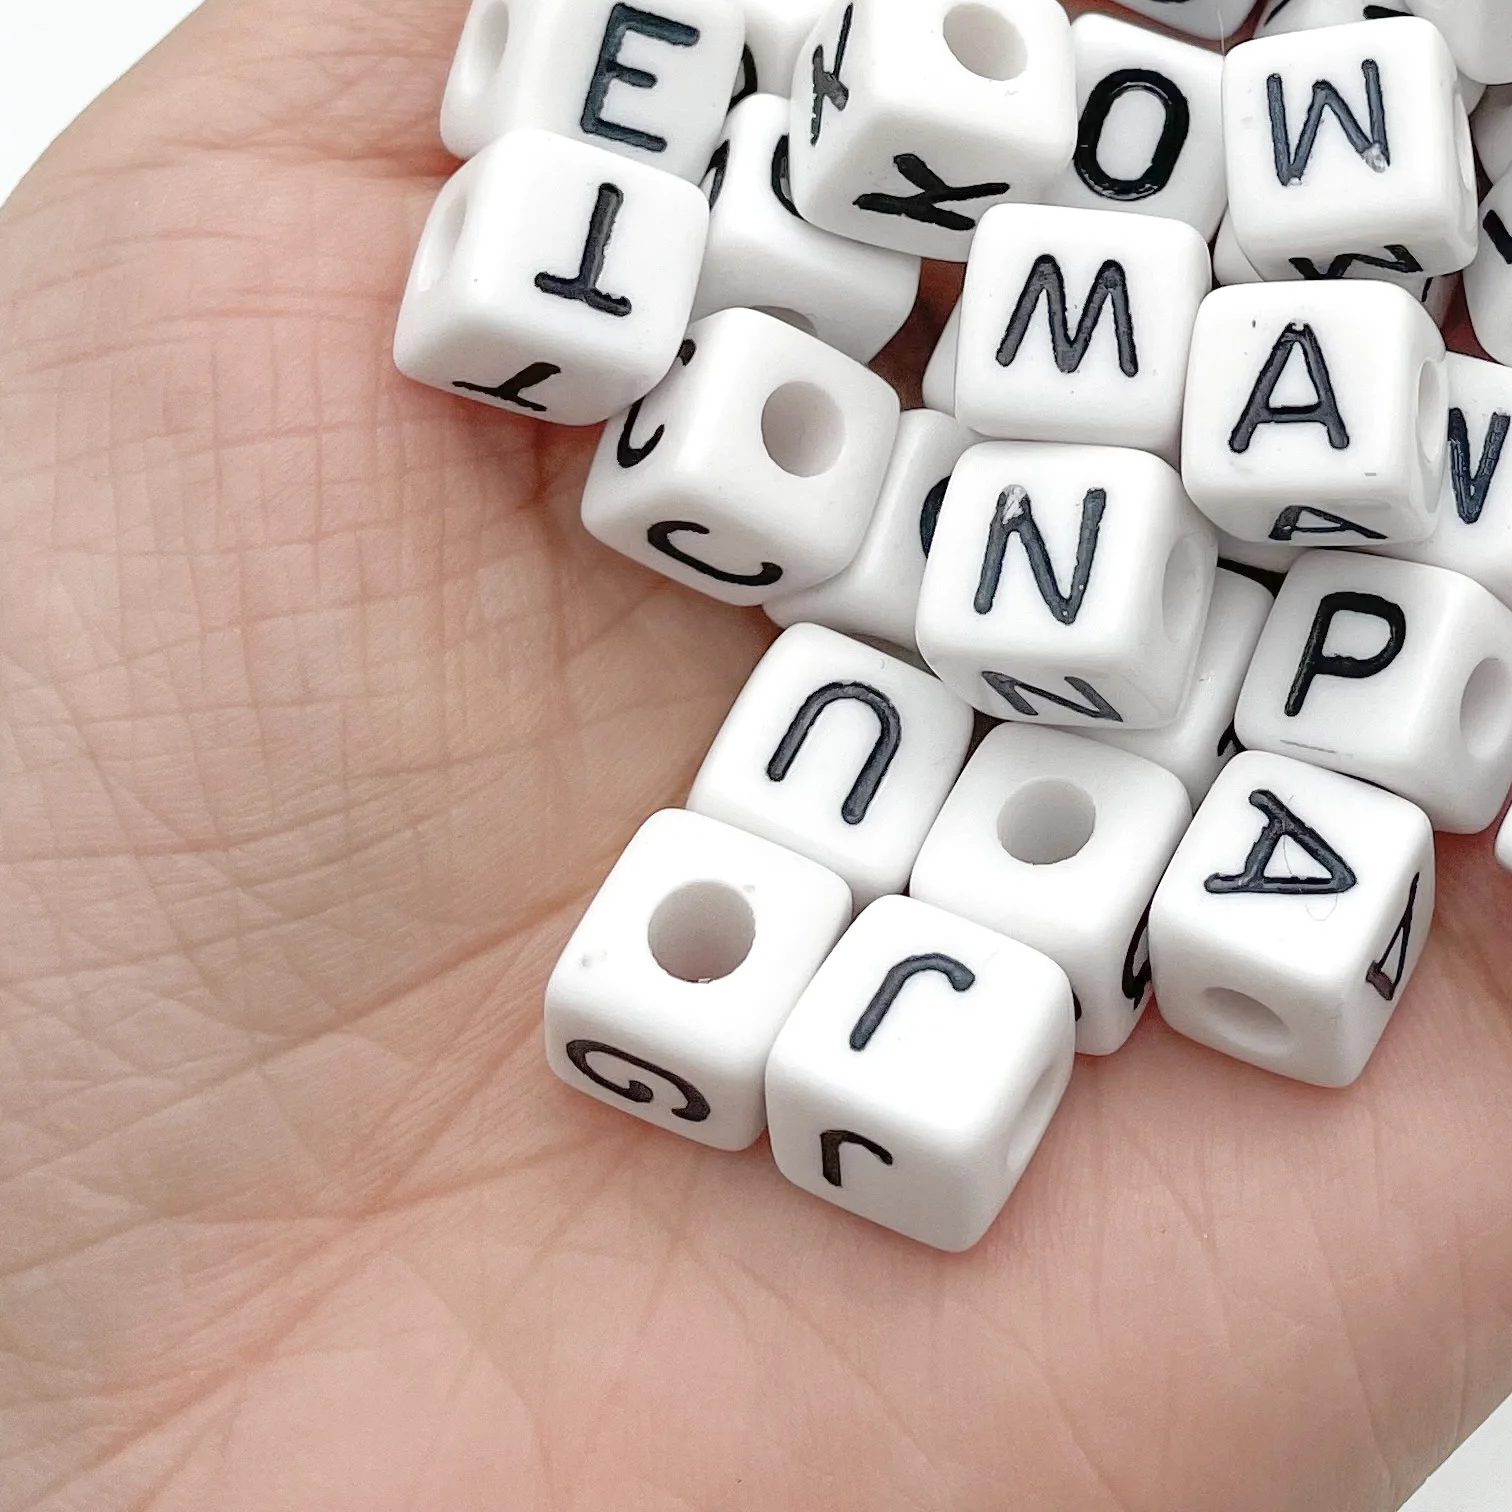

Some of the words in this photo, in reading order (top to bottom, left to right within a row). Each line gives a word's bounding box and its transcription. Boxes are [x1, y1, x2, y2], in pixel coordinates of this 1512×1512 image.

[580, 1, 701, 153] E
[1073, 67, 1190, 201] O
[533, 182, 633, 318] T
[852, 151, 1011, 232] K
[1228, 319, 1351, 454] A
[646, 519, 784, 587] C
[972, 484, 1108, 626] N
[1283, 590, 1407, 717] P
[765, 680, 903, 826] U
[1202, 788, 1358, 895] A
[565, 1038, 712, 1123] G
